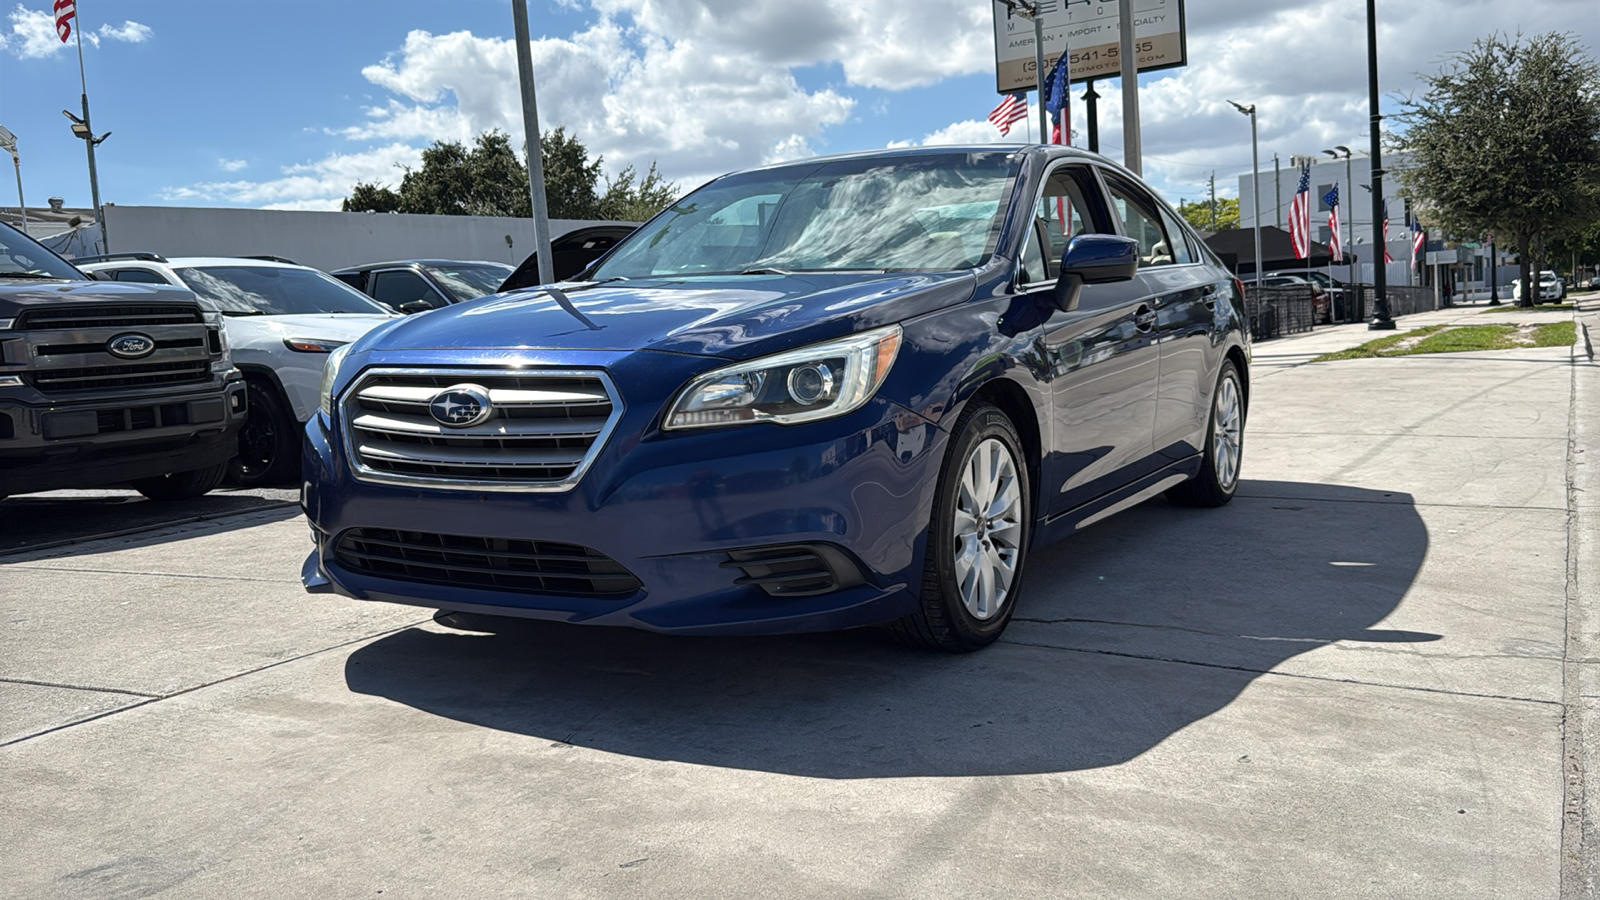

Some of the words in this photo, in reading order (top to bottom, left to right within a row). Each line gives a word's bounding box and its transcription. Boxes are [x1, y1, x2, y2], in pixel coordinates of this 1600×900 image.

[1008, 34, 1054, 48] AMERIAN
[1067, 26, 1102, 38] IMPORT
[1117, 15, 1166, 29] SCIALTY
[123, 340, 145, 351] Ford
